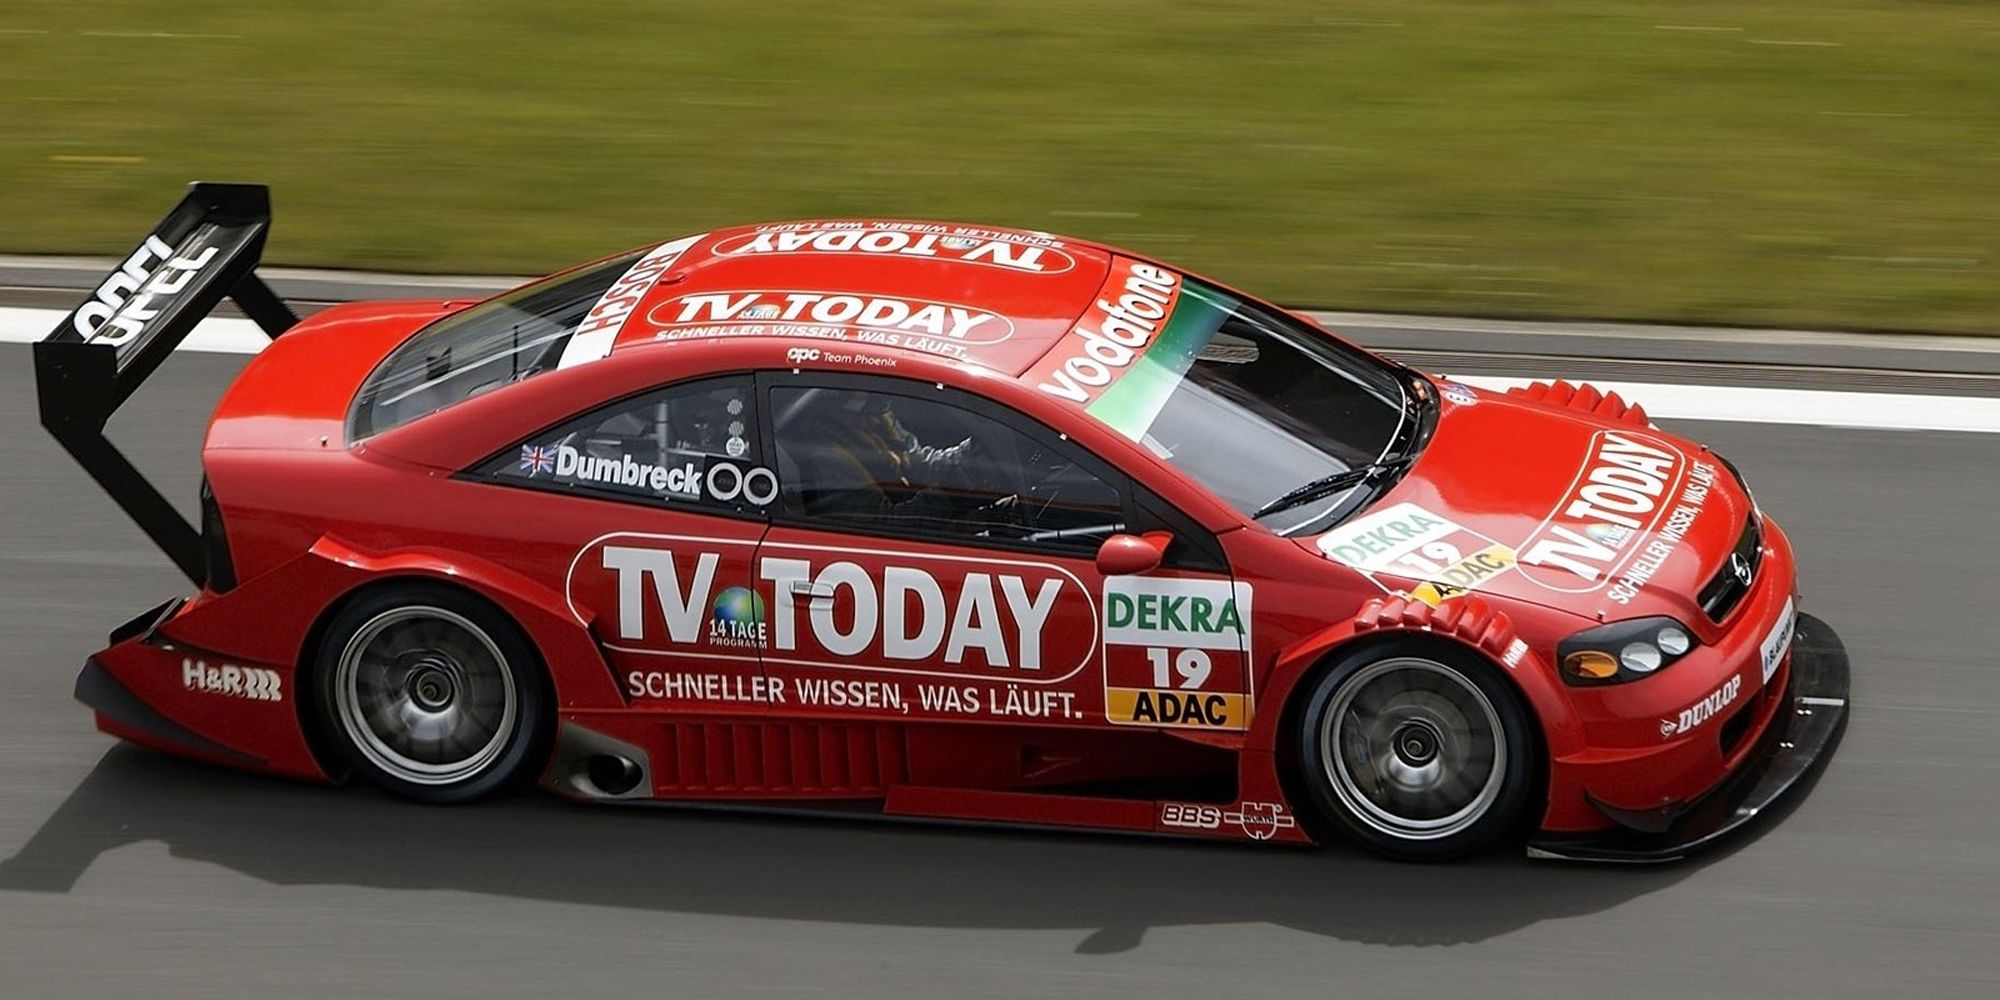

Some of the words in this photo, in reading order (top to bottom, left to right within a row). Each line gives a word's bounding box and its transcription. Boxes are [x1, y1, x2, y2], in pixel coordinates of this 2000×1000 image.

[733, 231, 938, 256] TODAY
[960, 241, 1045, 272] TV
[74, 234, 219, 347] OPEL
[577, 251, 676, 336] BOSCH
[655, 325, 764, 341] SCHNELLER
[857, 330, 900, 346] WAS
[674, 294, 763, 323] TV
[781, 294, 995, 339] TODAY
[1038, 263, 1177, 403] vodafone
[823, 352, 852, 363] Team
[854, 354, 897, 368] Phoenix
[556, 445, 702, 495] Dumbreck
[1565, 432, 1675, 530] TODAY
[1331, 513, 1445, 564] DEKRA
[1396, 541, 1463, 575] 19
[1522, 525, 1617, 581] TV
[1432, 553, 1505, 598] ADAC
[1607, 540, 1674, 605] SCHNELLER
[603, 545, 720, 644] TV
[760, 556, 1064, 670] TODAY
[710, 618, 727, 637] 14
[730, 620, 767, 640] TAGE
[1107, 592, 1245, 635] DEKRA
[710, 637, 768, 650] PROGRAMM
[183, 658, 246, 697] H&R
[1147, 647, 1212, 689] 19
[629, 671, 786, 703] SCHNELLER
[795, 678, 909, 714] WISSEN,
[918, 684, 981, 714] WAS
[990, 684, 1082, 719] LÄUFT.
[1132, 691, 1227, 726] ADAC
[1677, 674, 1741, 734] DUNLOP
[1161, 803, 1221, 828] BBS
